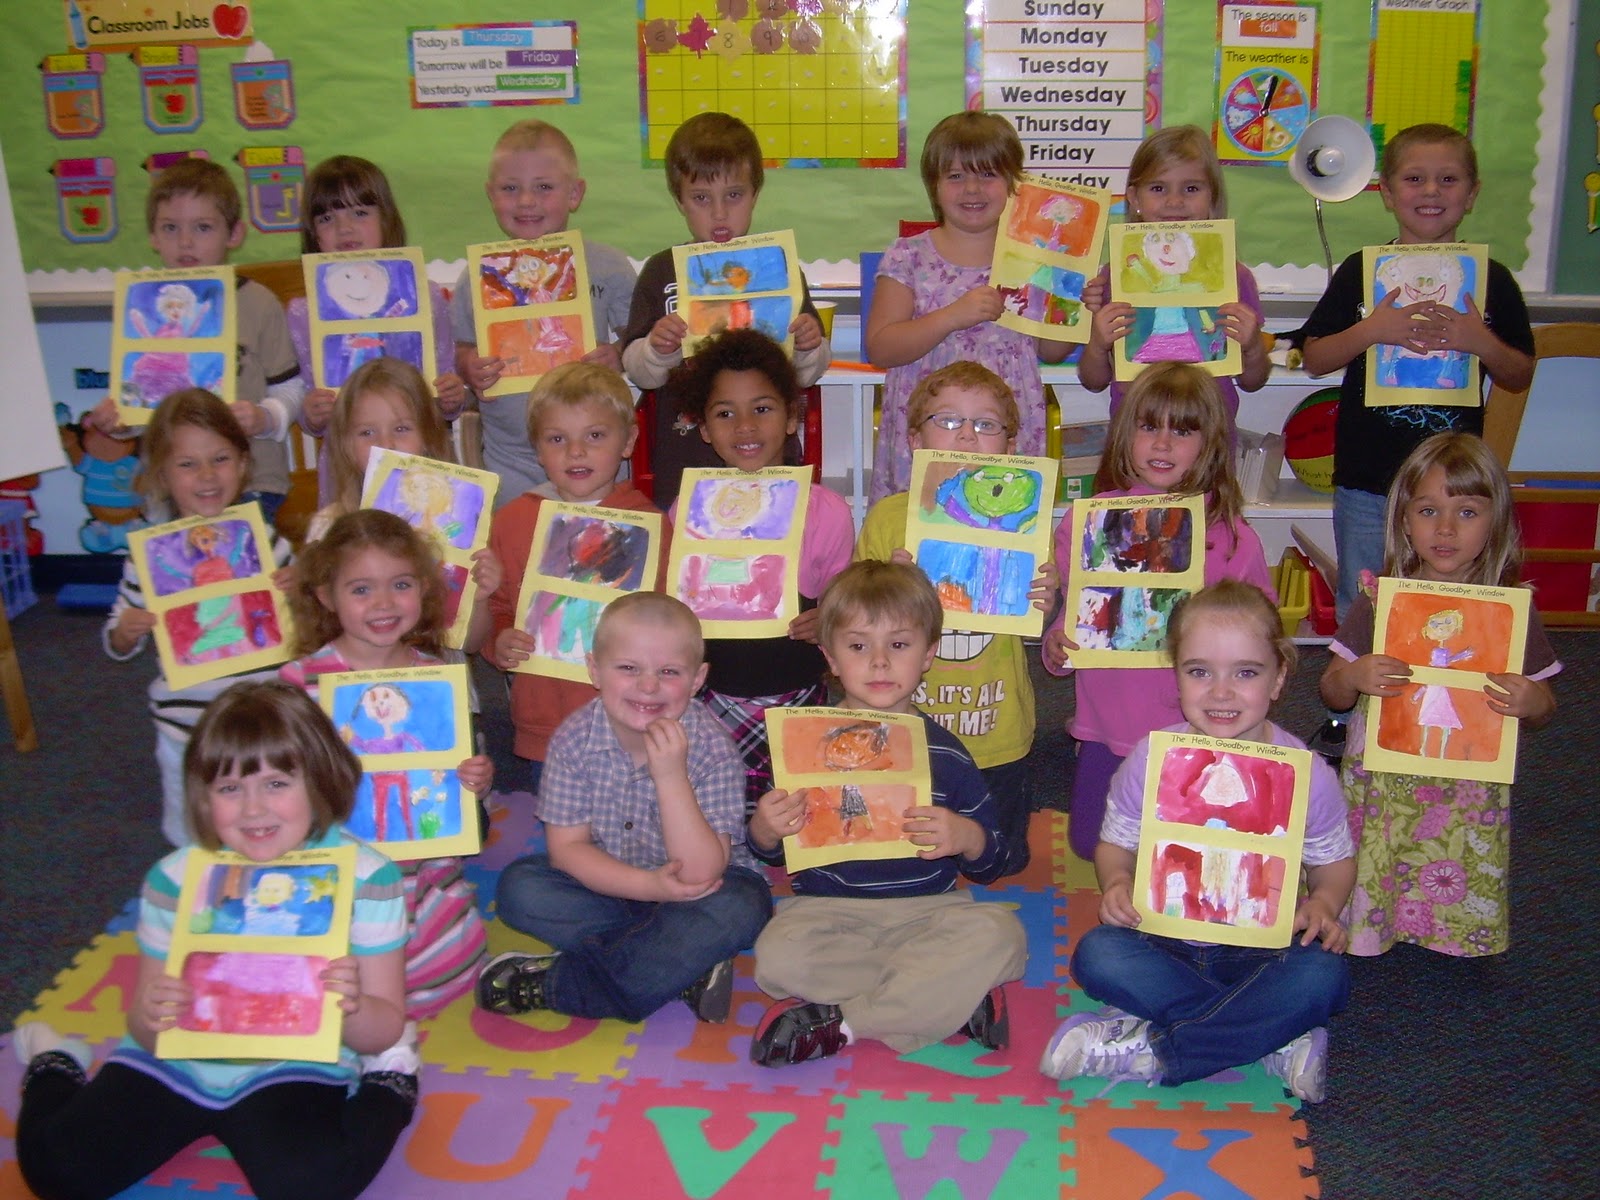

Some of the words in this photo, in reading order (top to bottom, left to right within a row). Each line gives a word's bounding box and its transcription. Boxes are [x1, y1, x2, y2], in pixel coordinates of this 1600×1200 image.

[1024, 0, 1105, 19] Sunday
[1232, 9, 1252, 21] The
[1255, 11, 1295, 21] season
[1297, 11, 1307, 22] is
[87, 15, 169, 34] Classroom
[173, 11, 210, 30] Jobs
[1259, 21, 1278, 33] fall
[415, 37, 449, 50] Today
[450, 36, 460, 47] is
[468, 30, 524, 44] Thursday
[723, 32, 733, 49] 8
[763, 30, 773, 46] 9
[1020, 27, 1108, 49] Monday
[416, 60, 468, 72] Tomorrow
[469, 59, 487, 70] will
[489, 58, 503, 69] be
[521, 50, 561, 64] Friday
[1018, 57, 1109, 77] Tuesday
[1225, 51, 1246, 63] The
[1249, 52, 1297, 64] weather
[1299, 53, 1309, 64] is
[417, 85, 472, 97] Yesterday
[474, 84, 497, 94] was
[499, 75, 562, 89] Wednesday
[1000, 86, 1127, 106] Wednesday
[1014, 115, 1112, 136] Thursday
[1029, 144, 1096, 164] Friday
[1124, 224, 1136, 232] The
[1159, 222, 1186, 231] Goodbye
[1190, 222, 1214, 230] Window
[1379, 246, 1390, 254] The
[931, 450, 945, 458] The
[971, 454, 1003, 464] Goodbye
[1007, 456, 1036, 466] Window
[1126, 496, 1154, 506] Goodbye
[1398, 580, 1411, 589] The
[1438, 583, 1472, 595] Goodbye
[1477, 588, 1506, 598] Window
[938, 684, 972, 704] IT'S
[976, 679, 1006, 709] ALL
[784, 707, 799, 716] The
[828, 708, 863, 718] Goodbye
[867, 711, 899, 721] Window
[958, 706, 998, 736] ME!
[1171, 734, 1186, 744] The
[1191, 735, 1213, 748] Hello,
[1215, 739, 1251, 752] Goodbye
[1256, 745, 1287, 757] Window
[404, 1092, 572, 1182] U
